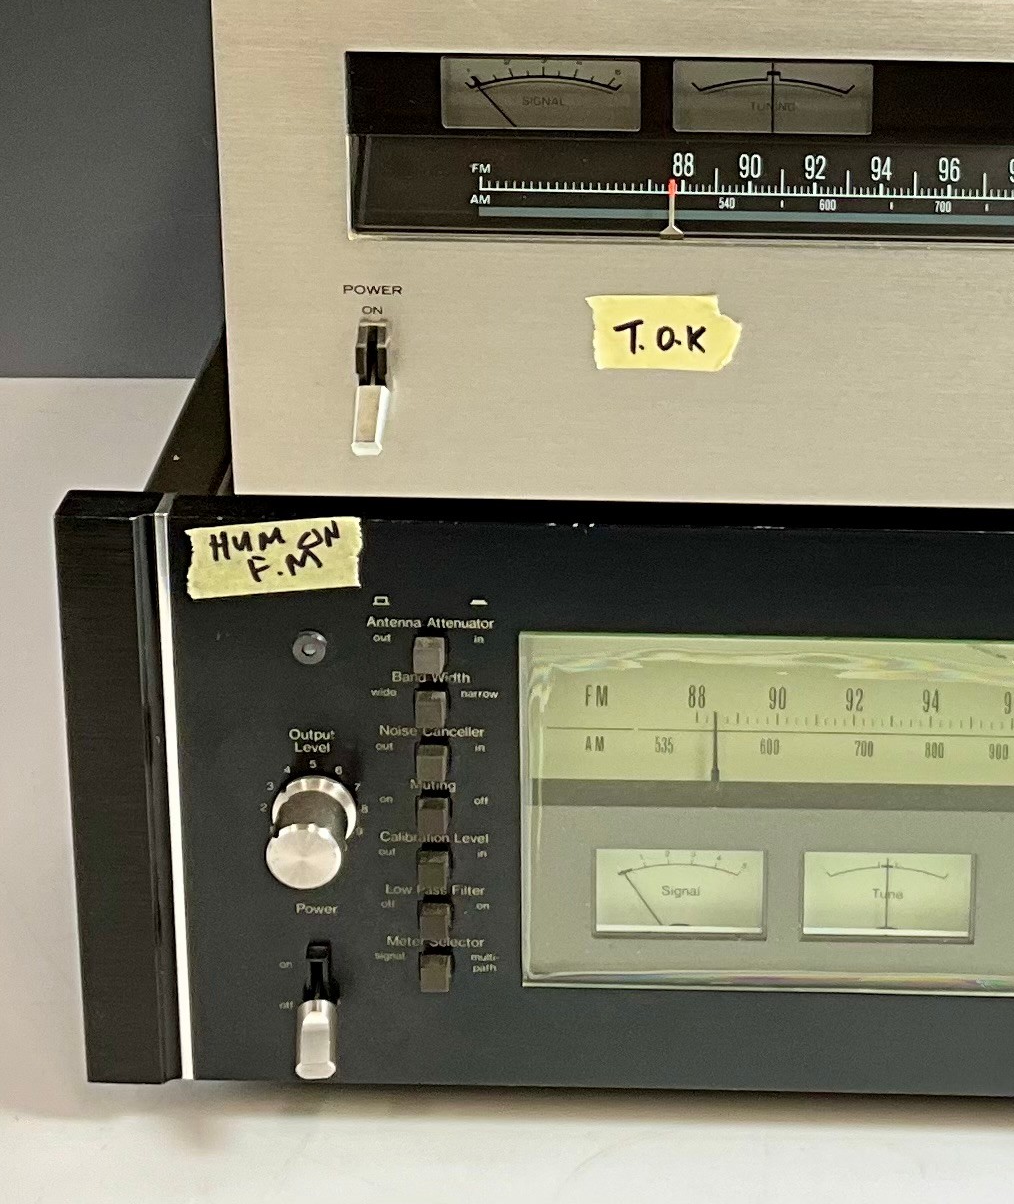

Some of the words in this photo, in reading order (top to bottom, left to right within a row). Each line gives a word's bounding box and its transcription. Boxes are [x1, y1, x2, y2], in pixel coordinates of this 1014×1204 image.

[521, 95, 565, 108] SIGNAL
[749, 101, 796, 113] TUNING
[470, 163, 492, 175] FM
[672, 152, 695, 178] 88
[738, 153, 762, 179] 90
[804, 154, 827, 181] 92
[870, 156, 893, 182] 94
[937, 158, 961, 183] 96
[469, 194, 491, 206] AM
[718, 196, 736, 210] 540
[818, 198, 837, 212] 600
[934, 200, 952, 214] 700
[342, 284, 403, 296] POWER
[361, 304, 383, 316] ON
[208, 526, 287, 562] HUM
[296, 519, 341, 551] ON
[366, 615, 422, 629] Antenna
[426, 616, 495, 630] Attenuator
[372, 632, 391, 643] out
[473, 633, 485, 644] in
[370, 687, 397, 698] wide
[460, 689, 499, 699] narrow
[584, 684, 609, 708] FM
[687, 684, 707, 709] 88
[768, 686, 787, 711] 90
[845, 687, 864, 713] 92
[921, 688, 940, 714] 94
[288, 728, 336, 741] Output
[378, 724, 418, 737] Noise
[294, 742, 331, 754] Level
[374, 742, 394, 752] out
[474, 743, 486, 753] in
[584, 735, 605, 752] AM
[654, 735, 674, 754] 535
[759, 737, 780, 756] 600
[854, 739, 874, 758] 700
[924, 741, 945, 759] 800
[988, 743, 1009, 761] 900
[379, 795, 394, 804] on
[473, 796, 490, 806] off
[453, 832, 490, 845] Level
[378, 847, 396, 857] out
[476, 849, 488, 859] in
[385, 884, 413, 896] Low
[451, 884, 486, 897] Filter
[660, 884, 701, 899] Signal
[295, 903, 338, 915] Power
[475, 901, 490, 911] on
[374, 951, 406, 962] signal
[472, 963, 497, 974] path
